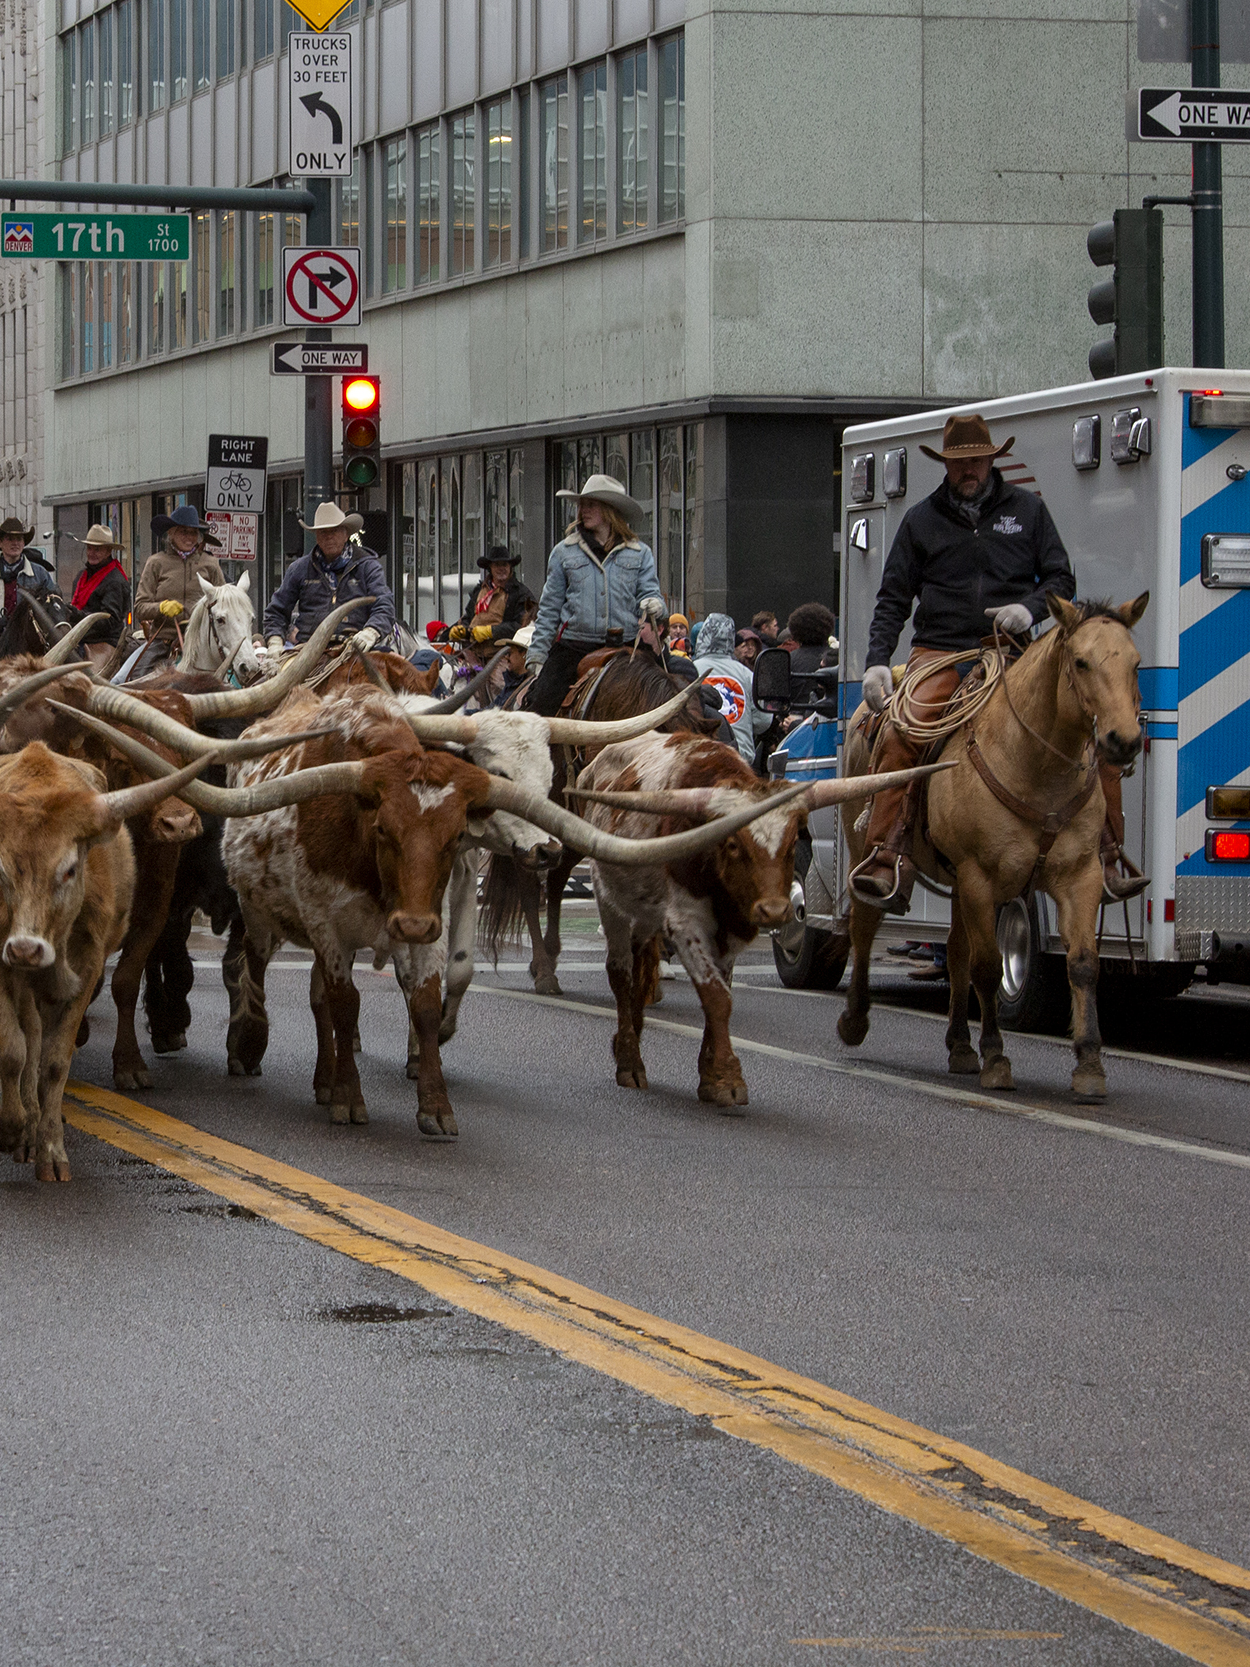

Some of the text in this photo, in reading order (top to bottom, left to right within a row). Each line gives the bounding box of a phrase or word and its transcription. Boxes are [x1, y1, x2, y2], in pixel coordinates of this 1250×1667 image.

[294, 38, 347, 50] TRUCKS
[302, 54, 338, 66] OVER
[293, 71, 347, 82] 30 FEET
[1178, 104, 1218, 123] ONE
[296, 152, 347, 170] ONLY
[157, 223, 170, 237] St
[51, 221, 125, 252] 17th
[5, 241, 33, 252] DENVER
[148, 238, 179, 252] 1700
[302, 352, 358, 364] ONE WAY
[221, 440, 255, 450] RIGHT
[221, 452, 253, 463] LANE
[217, 493, 253, 507] ONLY
[239, 516, 249, 526] NO
[233, 526, 255, 535] PARKING
